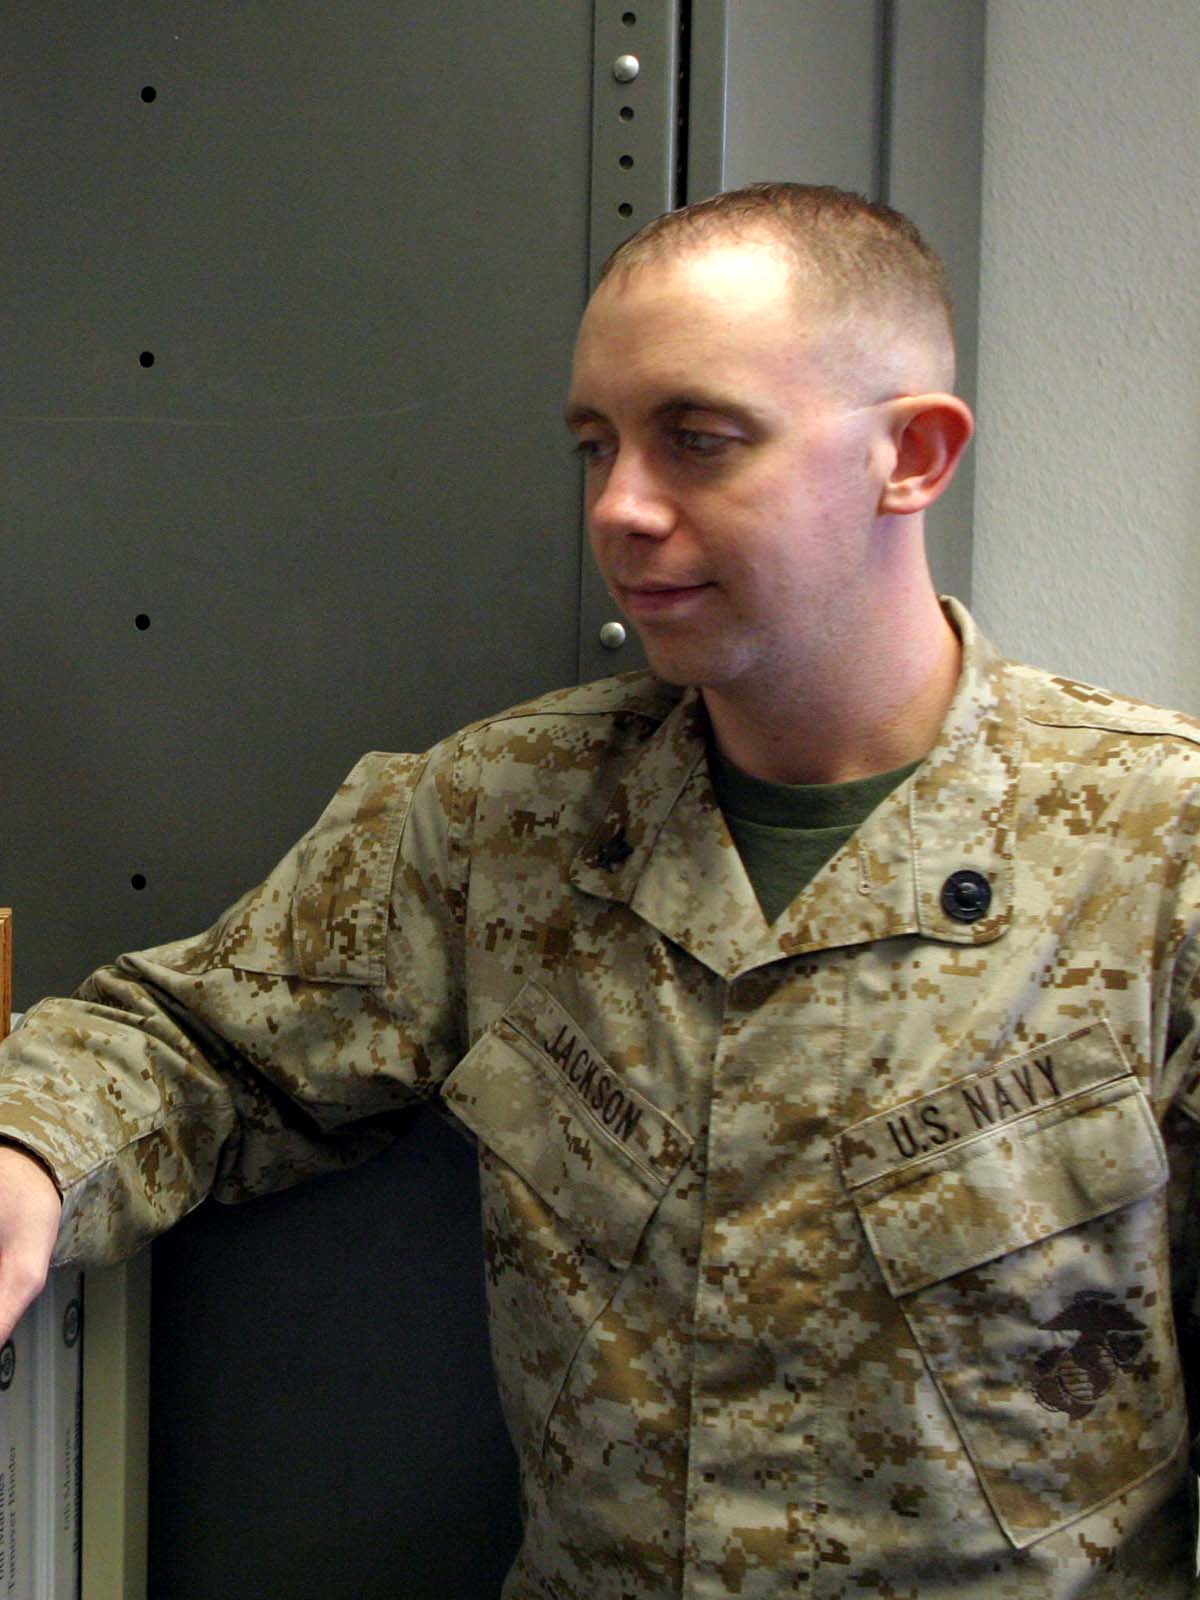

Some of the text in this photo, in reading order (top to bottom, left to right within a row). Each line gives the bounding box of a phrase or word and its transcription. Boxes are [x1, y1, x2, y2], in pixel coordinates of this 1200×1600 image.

[543, 1024, 644, 1143] JACKSON
[886, 1055, 1061, 1158] U.S. NAVY
